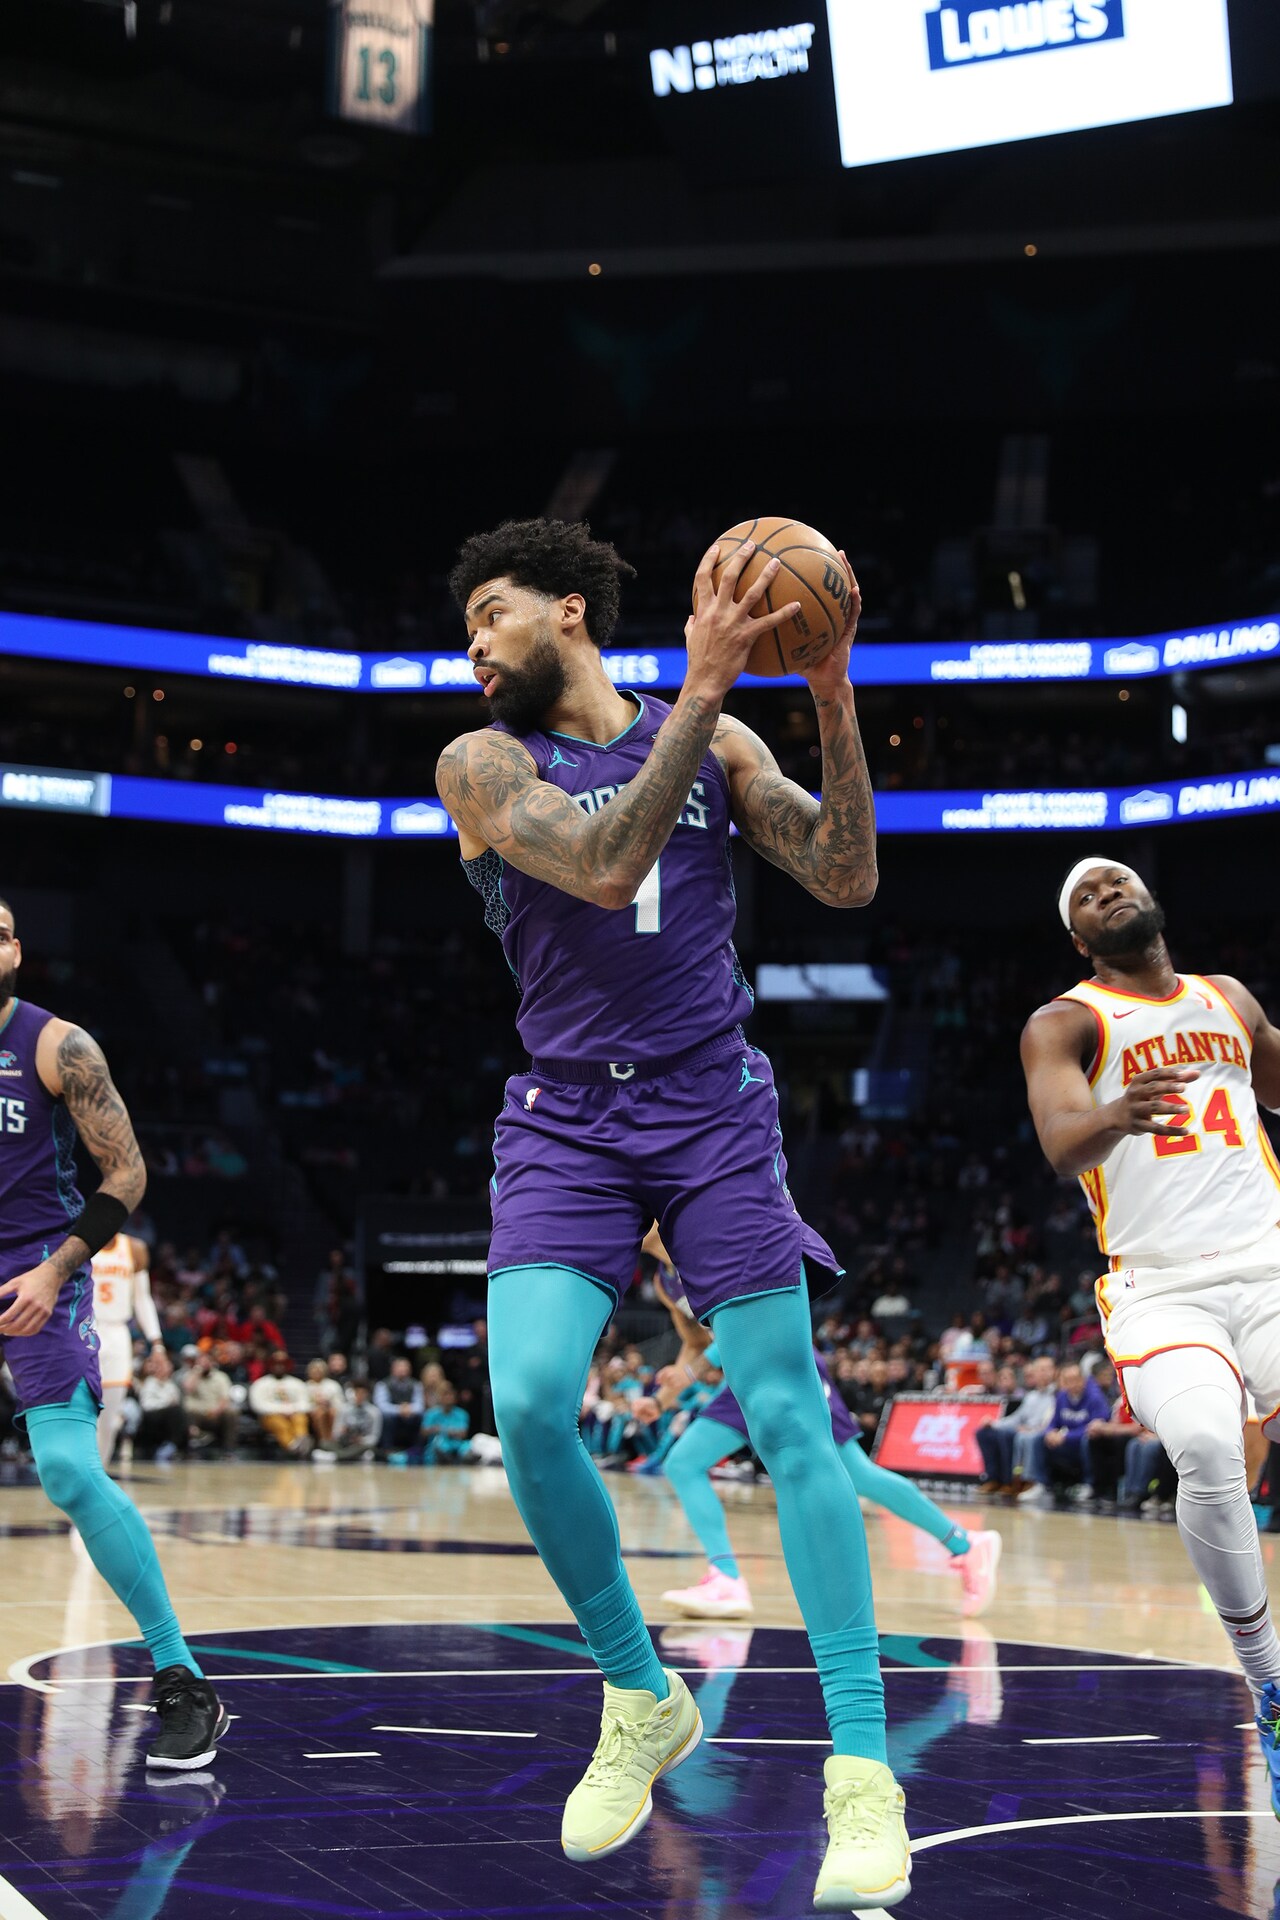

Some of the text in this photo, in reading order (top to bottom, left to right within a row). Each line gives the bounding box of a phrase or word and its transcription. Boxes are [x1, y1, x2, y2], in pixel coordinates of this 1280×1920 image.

[358, 47, 396, 104] 13
[716, 49, 809, 87] HEALTH
[1178, 776, 1280, 815] DRILLIN
[1122, 1031, 1248, 1088] ATLANTA
[1152, 1087, 1245, 1159] 24
[911, 1414, 969, 1444] DEX
